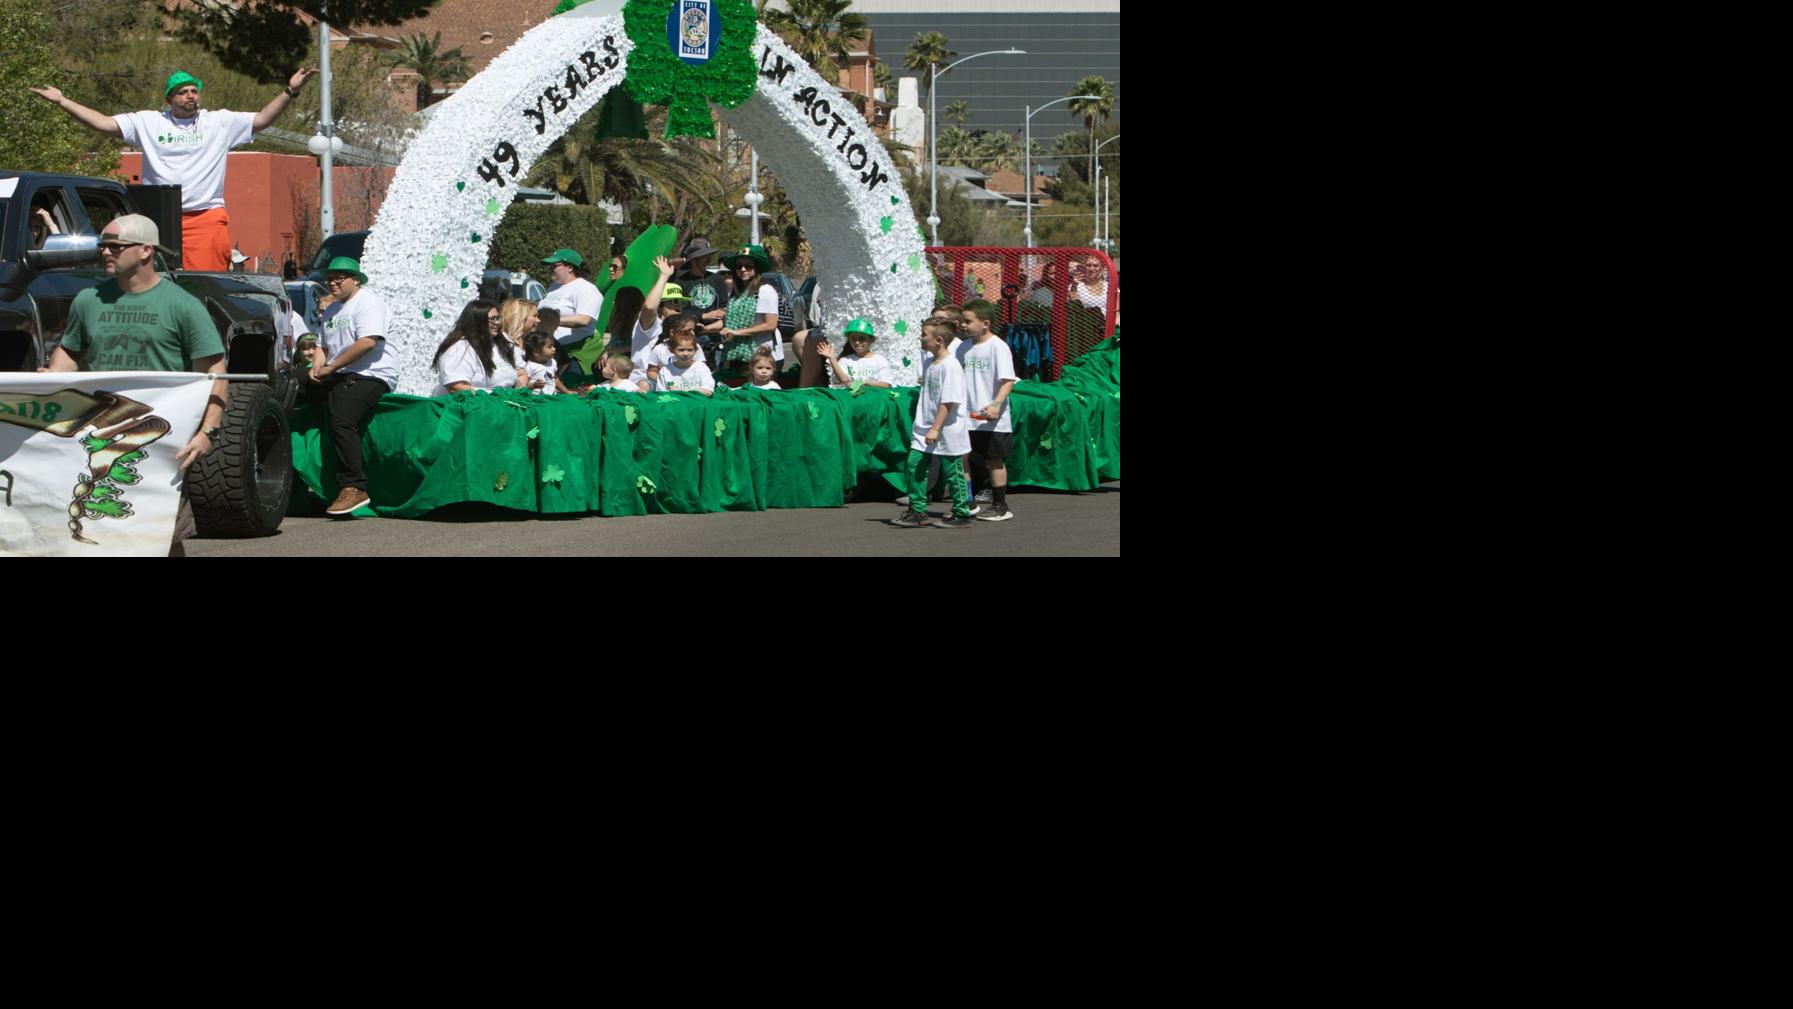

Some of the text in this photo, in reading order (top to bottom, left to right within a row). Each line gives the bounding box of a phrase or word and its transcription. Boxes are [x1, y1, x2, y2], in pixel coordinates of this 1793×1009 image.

[477, 35, 888, 191] 49 YEARS IN ACTION
[174, 132, 202, 143] IRISH
[98, 311, 159, 326] ATTITUDE
[99, 353, 123, 367] CAN
[966, 360, 990, 370] IRSH
[680, 378, 703, 389] IRSH
